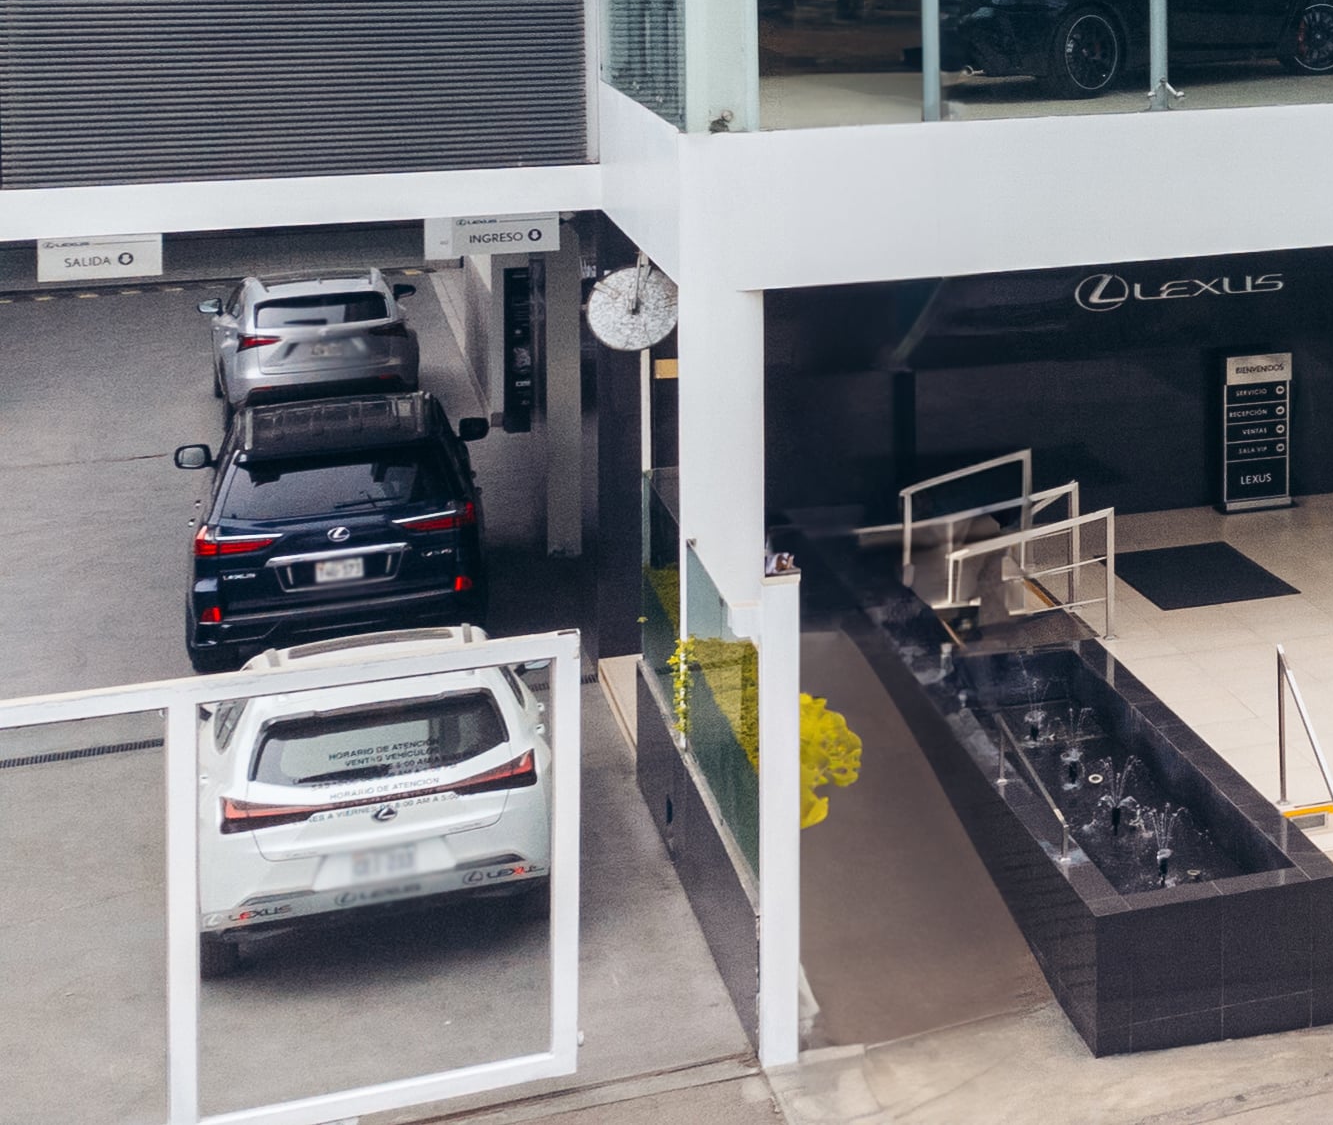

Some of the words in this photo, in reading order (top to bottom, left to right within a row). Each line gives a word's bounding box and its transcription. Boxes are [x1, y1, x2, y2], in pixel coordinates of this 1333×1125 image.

[469, 231, 524, 244] INGRESO
[64, 255, 112, 268] SALIDA
[1133, 273, 1284, 301] LEXUS
[1235, 362, 1285, 375] BIENVENIDOS
[1235, 388, 1268, 397] SERVICIO
[1229, 407, 1268, 418] RECEPCIÓN
[1242, 427, 1268, 435] VENTAS
[1257, 445, 1268, 453] VIP
[1240, 472, 1273, 486] LEXUS
[328, 747, 374, 761] HORARIO
[376, 745, 389, 754] DE
[329, 786, 374, 801] HORARIO
